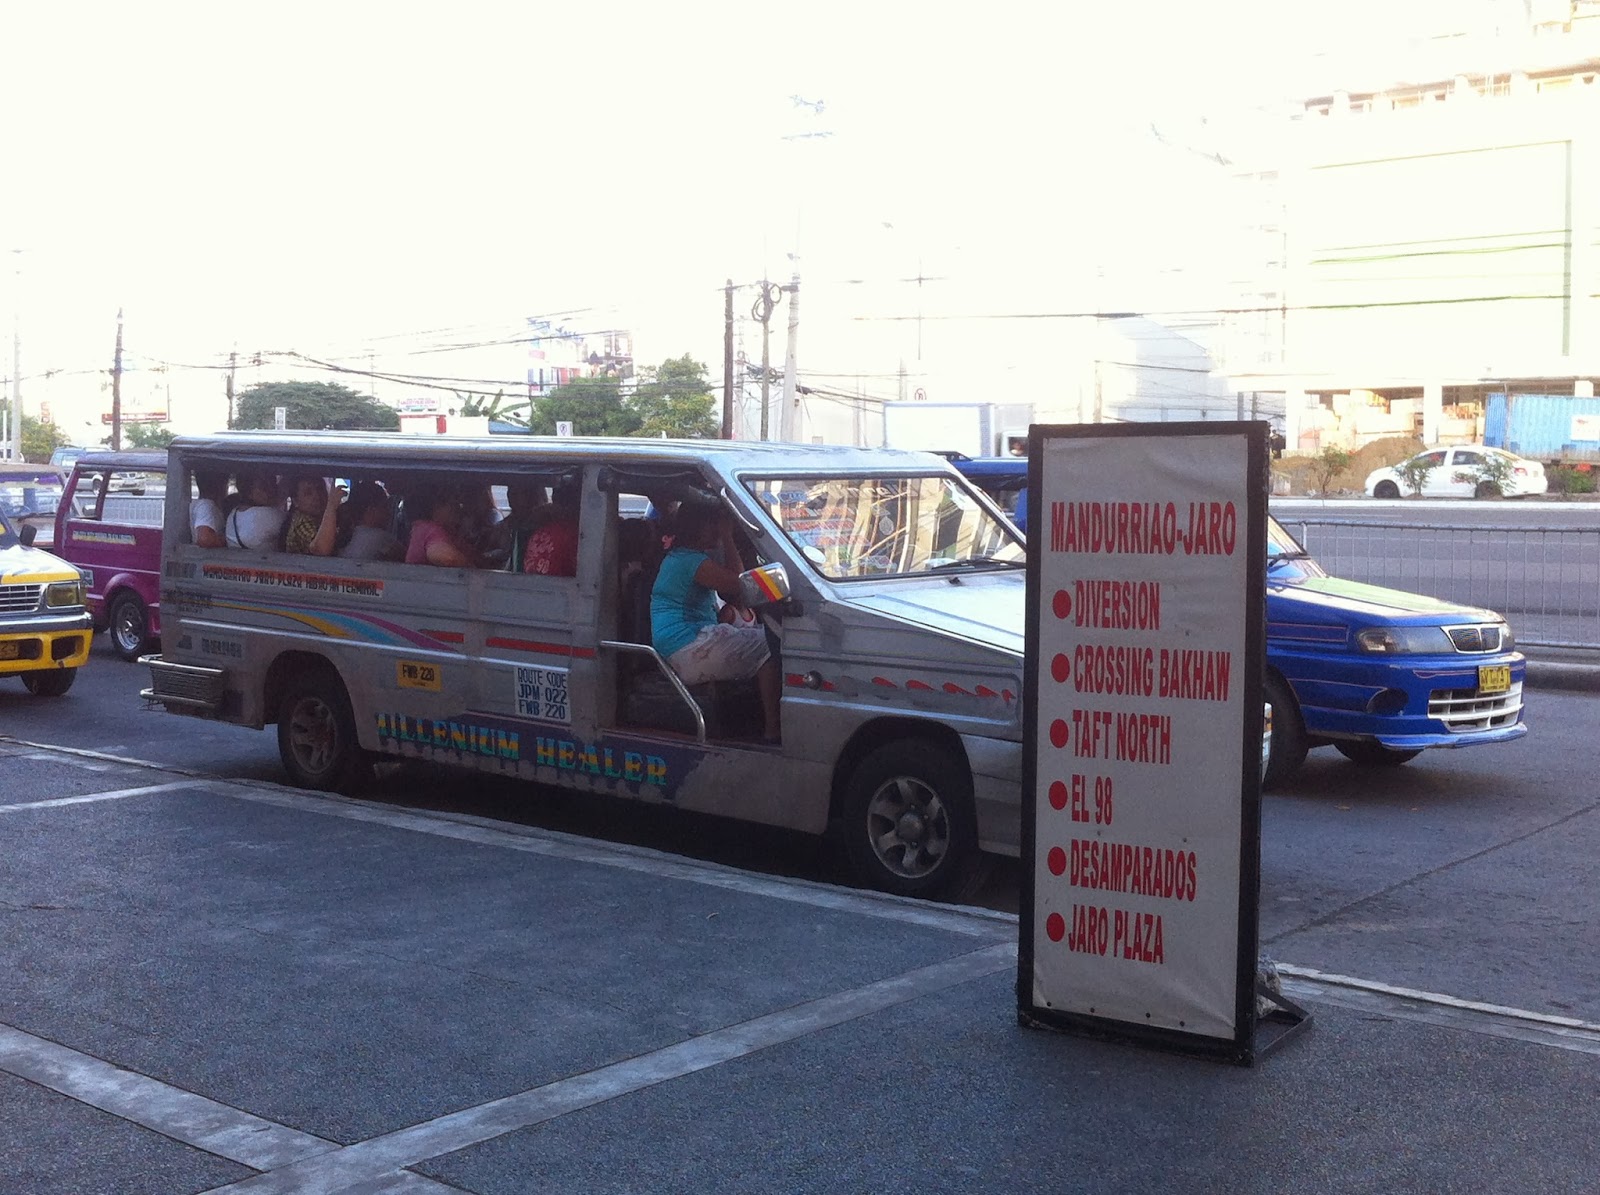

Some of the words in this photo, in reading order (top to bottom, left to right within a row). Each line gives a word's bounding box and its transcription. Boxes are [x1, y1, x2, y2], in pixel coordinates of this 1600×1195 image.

[1051, 501, 1236, 555] MANDURRIAO-JARO
[1076, 581, 1160, 630] DIVERSION
[517, 667, 544, 686] ROUTE
[546, 671, 567, 689] CODE
[1075, 646, 1153, 697] CROSSING
[1160, 649, 1231, 701] BAKHAW
[536, 736, 668, 787] HEALER
[1073, 710, 1111, 757] TAFT
[1116, 713, 1171, 764] NORTH
[1072, 775, 1090, 822] EL
[1094, 776, 1113, 825] 98
[1071, 840, 1197, 902] DESAMPARADOS
[1068, 906, 1108, 956] JARO
[1114, 909, 1164, 964] PLAZA
